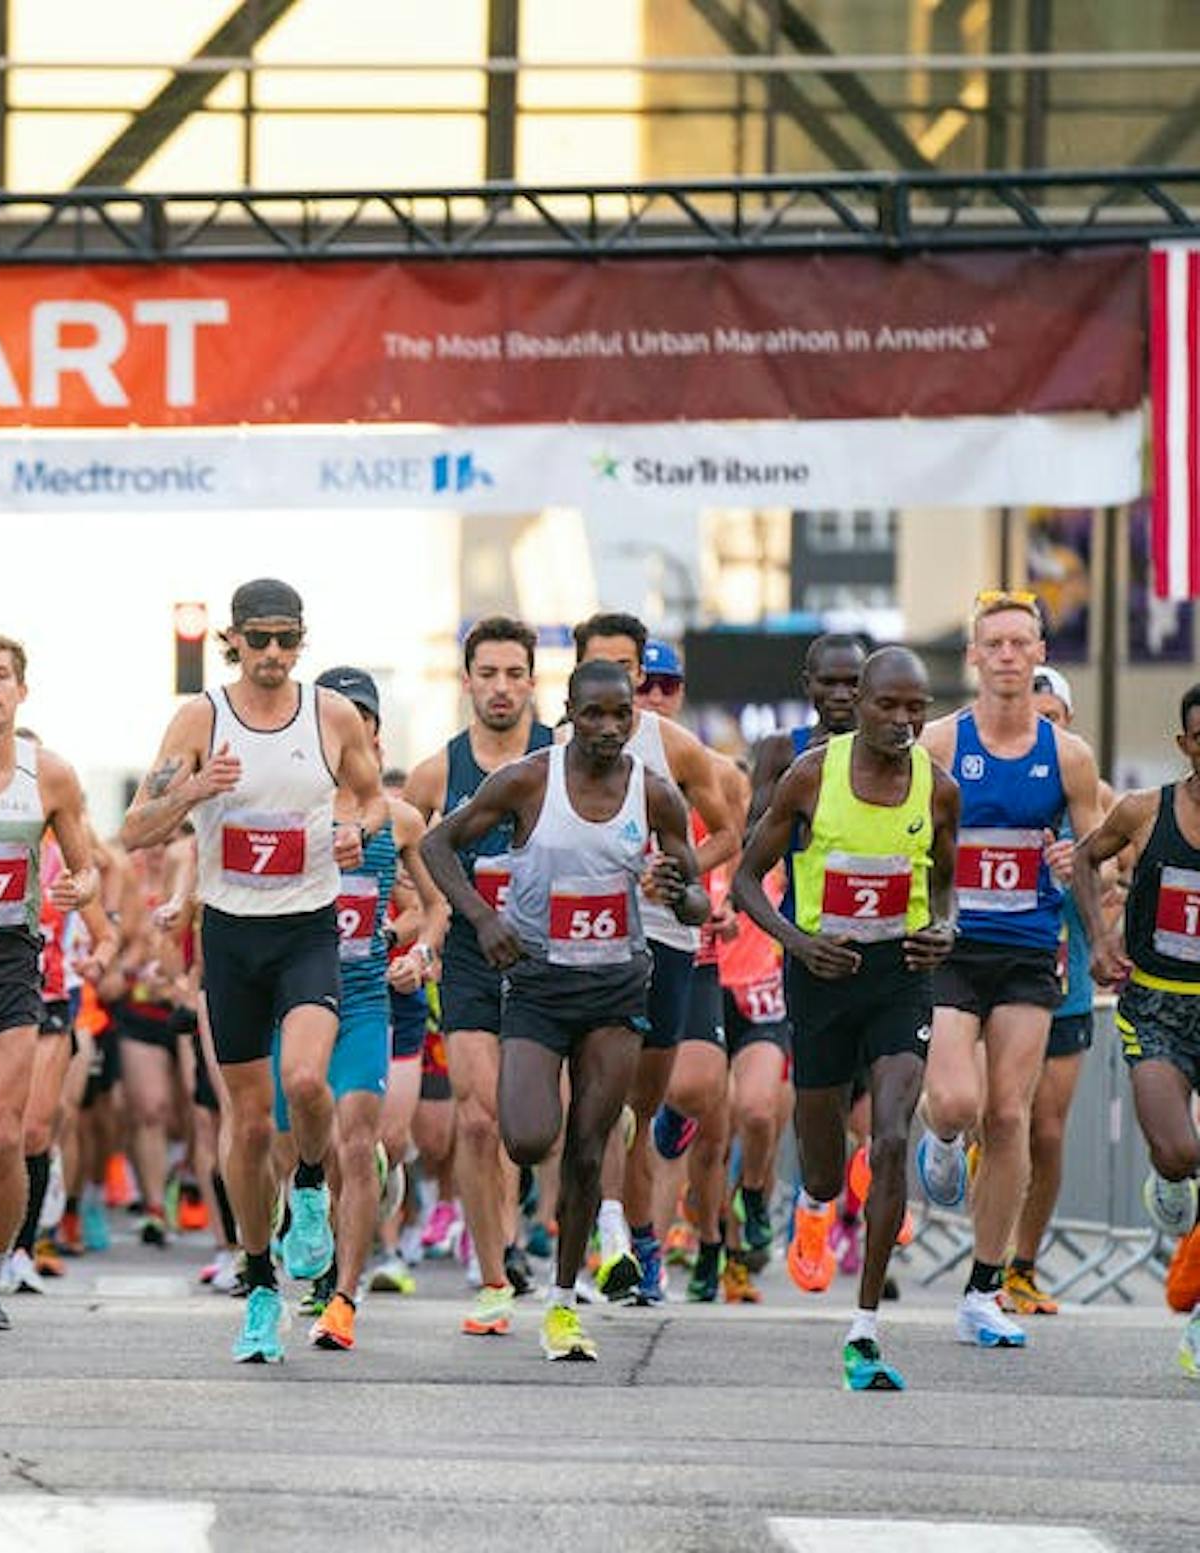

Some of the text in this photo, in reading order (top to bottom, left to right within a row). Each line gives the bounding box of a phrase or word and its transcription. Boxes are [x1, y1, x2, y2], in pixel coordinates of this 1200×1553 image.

[383, 332, 432, 360] The
[437, 333, 500, 360] Most
[504, 329, 624, 359] Beautiful
[629, 331, 710, 356] Urban
[713, 327, 839, 353] Marathon
[844, 329, 870, 351] in
[12, 458, 216, 493] Medtronic
[321, 458, 422, 492] KARE
[633, 457, 810, 485] StarTribune
[250, 844, 277, 874] 7
[979, 860, 1020, 890] 10
[853, 888, 879, 918] 2
[569, 909, 617, 940] 56
